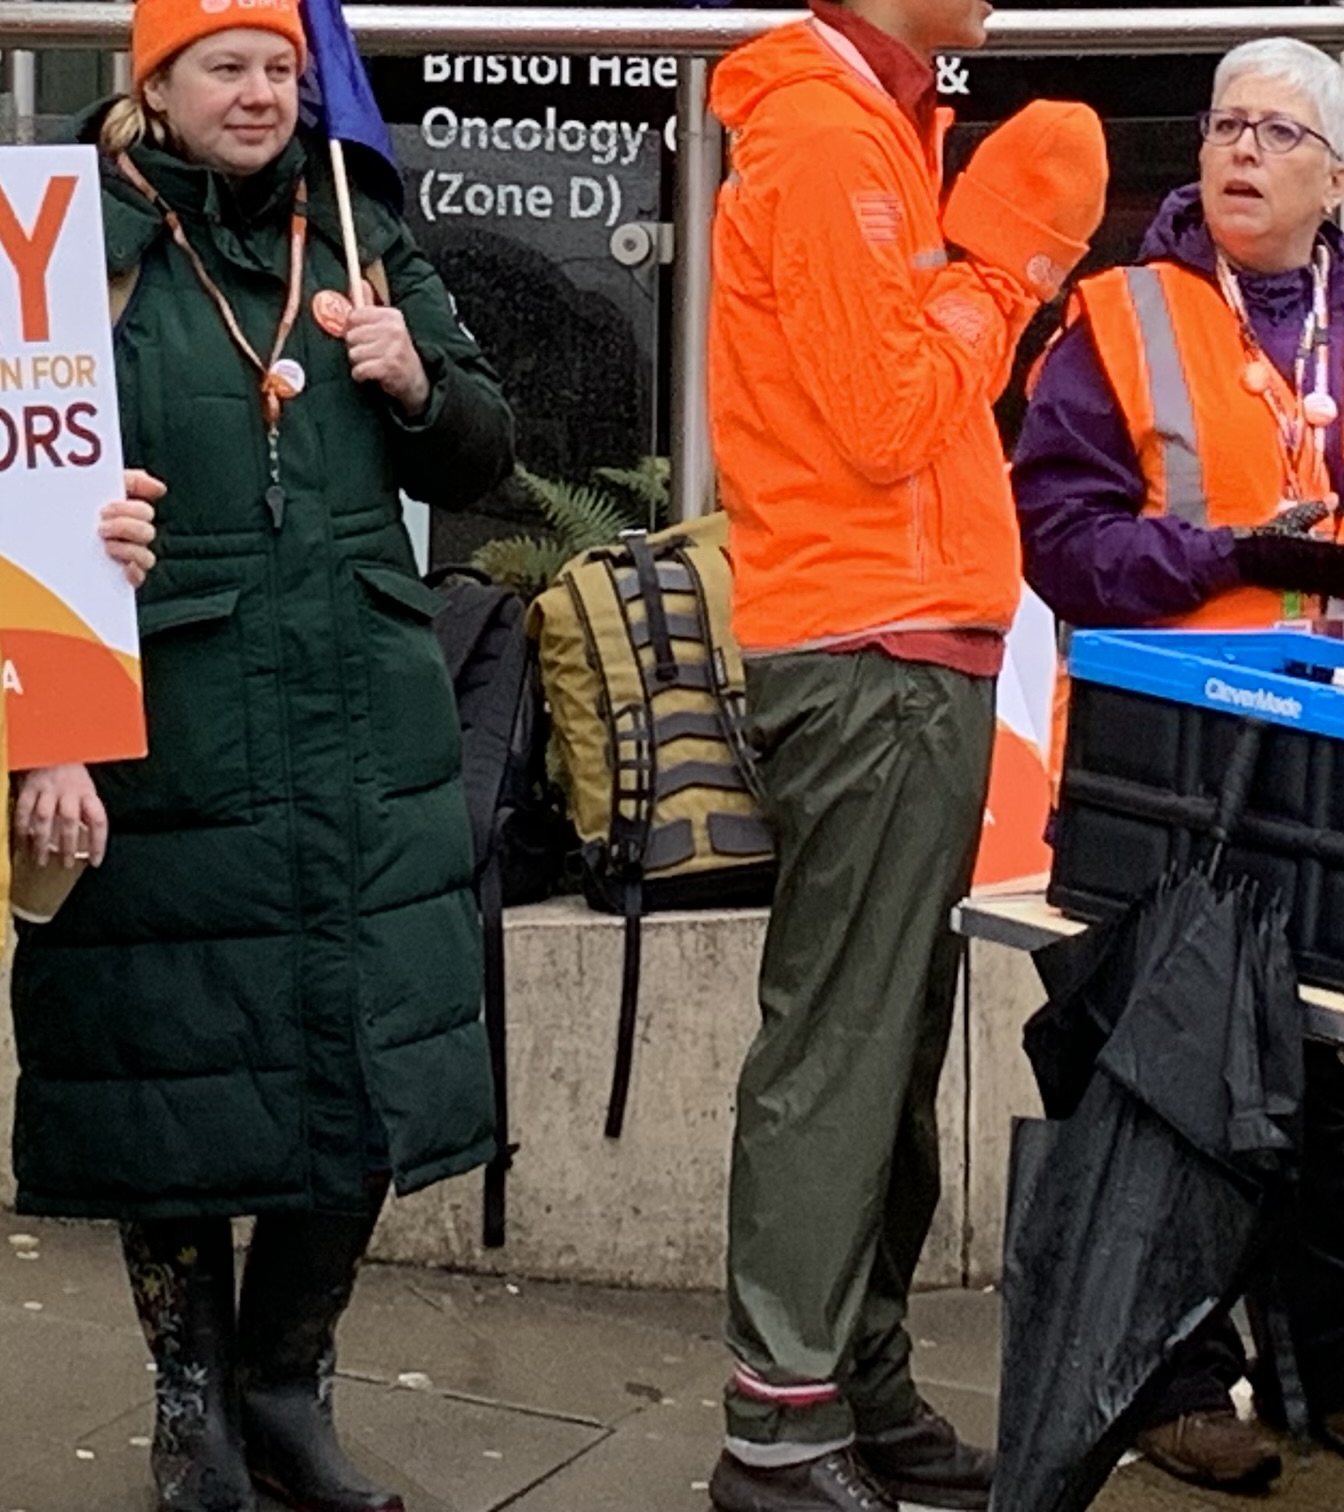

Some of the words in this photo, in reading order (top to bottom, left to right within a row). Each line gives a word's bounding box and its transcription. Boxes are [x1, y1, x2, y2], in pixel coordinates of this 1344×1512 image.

[423, 54, 570, 85] Bristol
[936, 55, 970, 95] &
[421, 106, 649, 165] Oncology
[420, 169, 554, 221] (Zone
[570, 173, 622, 227] D)
[32, 354, 96, 389] FOR
